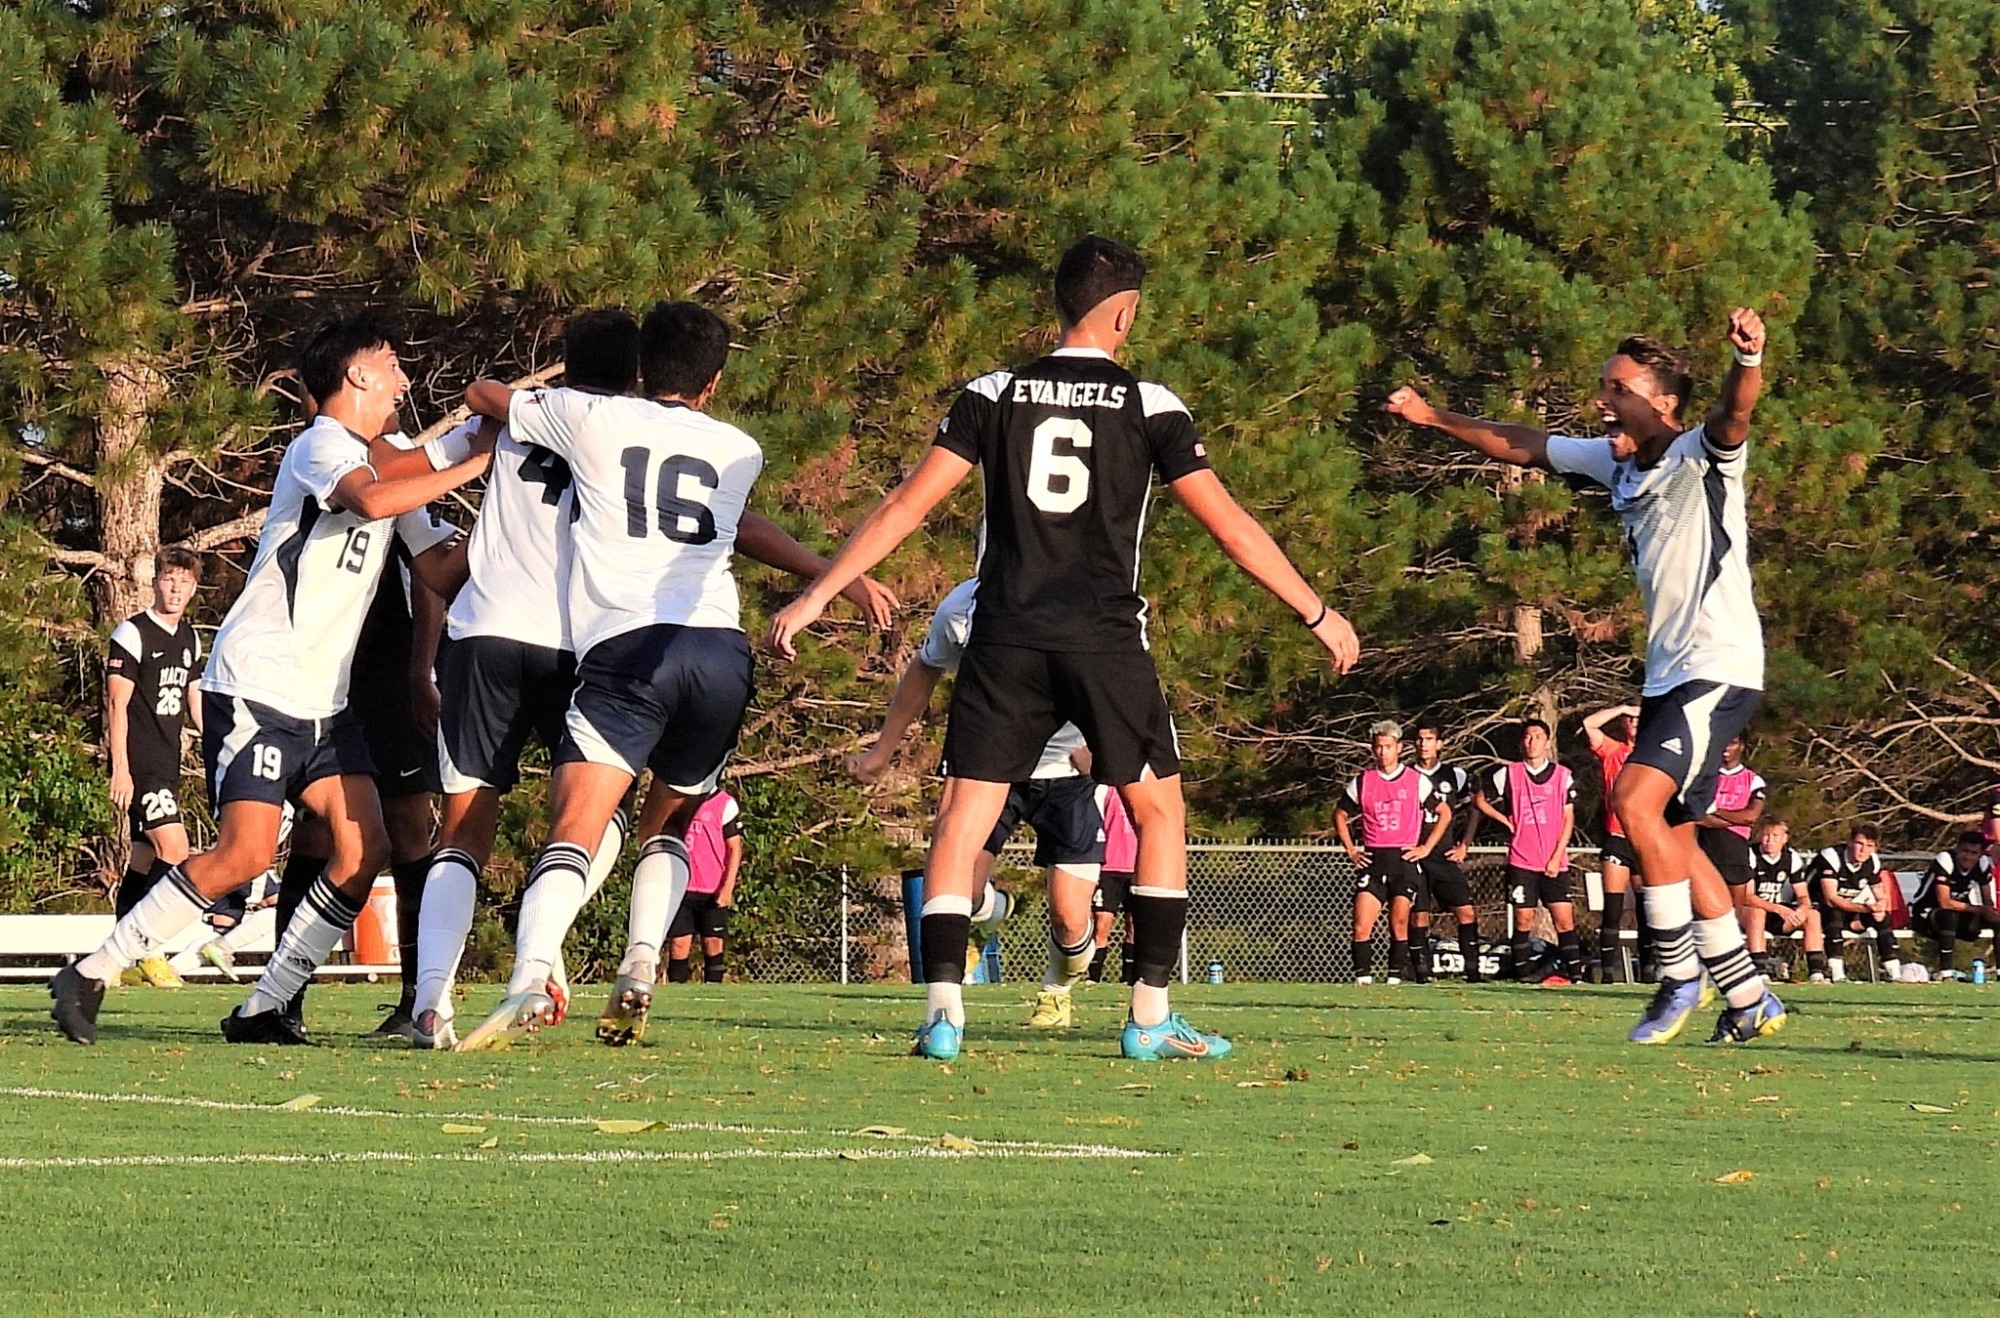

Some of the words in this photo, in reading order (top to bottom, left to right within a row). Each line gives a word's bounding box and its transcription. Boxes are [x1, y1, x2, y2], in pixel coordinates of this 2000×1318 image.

[1012, 379, 1127, 409] EVANGELS
[1026, 416, 1094, 513] 6
[620, 446, 719, 545] 16
[336, 526, 370, 574] 19
[159, 666, 188, 687] MACU
[156, 687, 182, 715] 26
[252, 743, 282, 781] 19
[141, 788, 178, 821] 26
